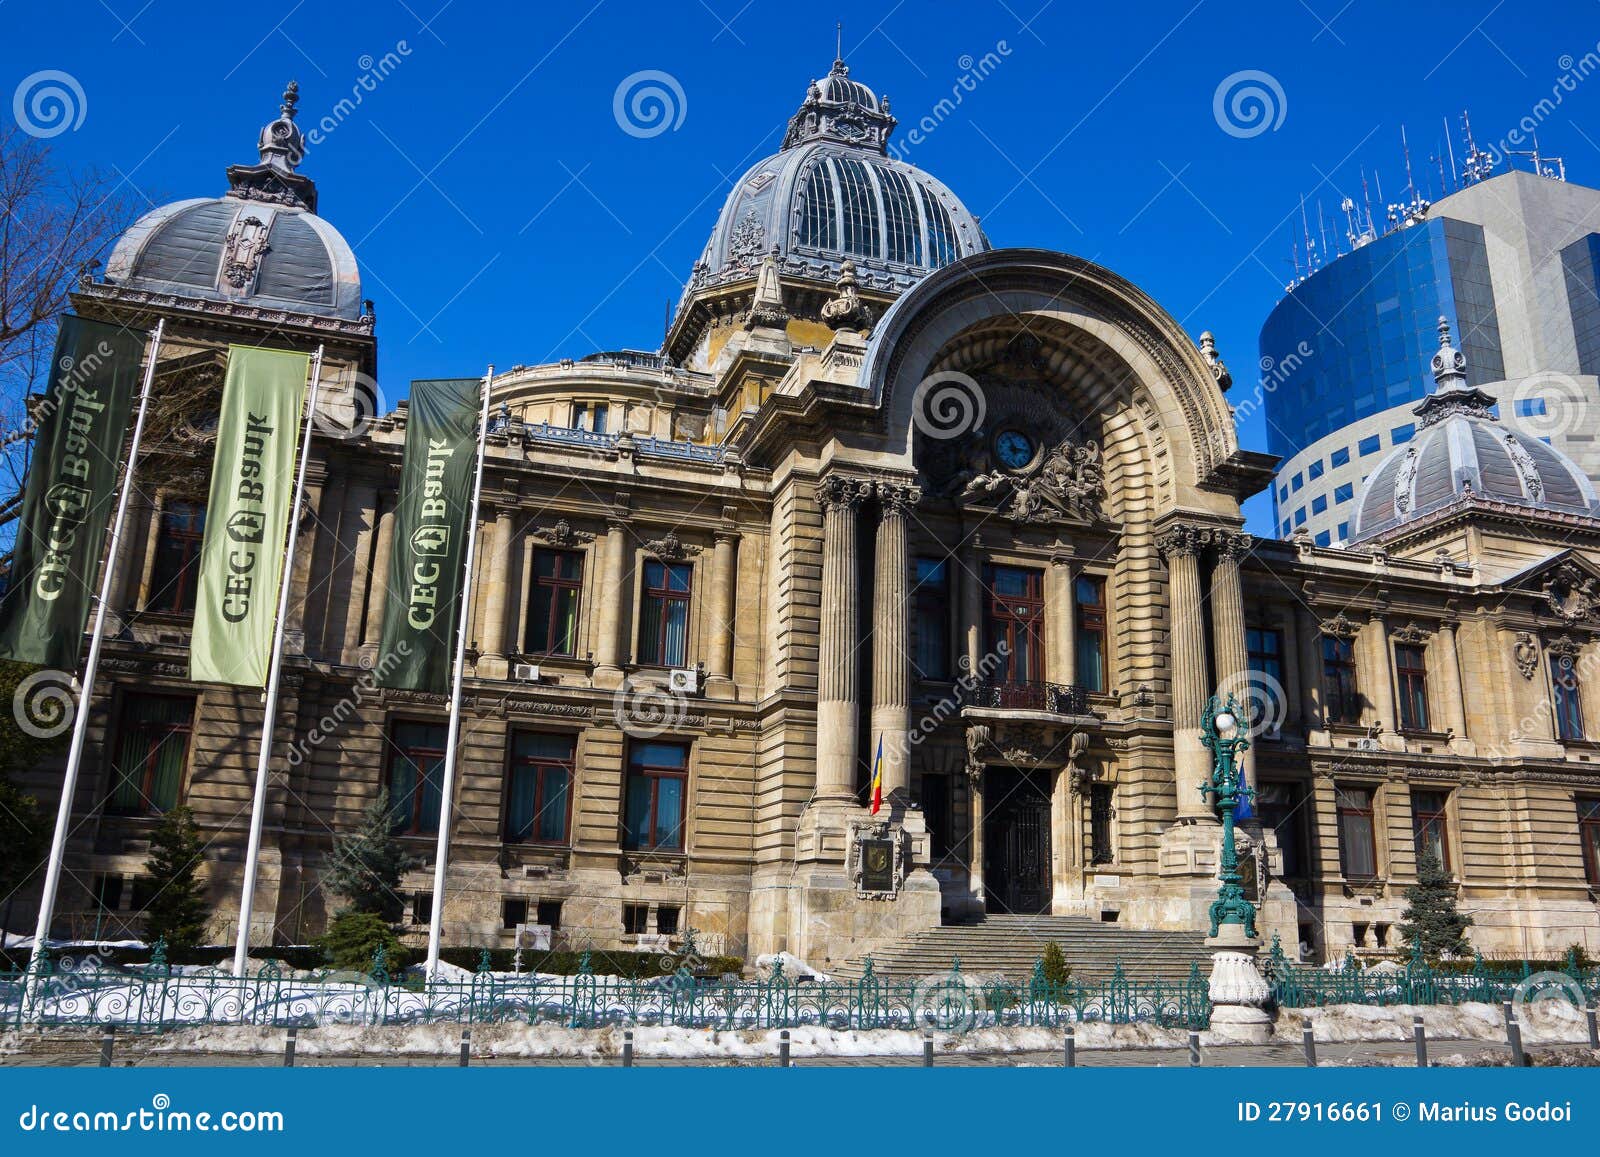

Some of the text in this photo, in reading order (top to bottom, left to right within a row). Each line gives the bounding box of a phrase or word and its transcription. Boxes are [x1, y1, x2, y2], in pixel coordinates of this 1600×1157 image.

[61, 385, 105, 482] Bank
[222, 411, 275, 624] CEC Bank
[407, 437, 455, 630] CEC Bank
